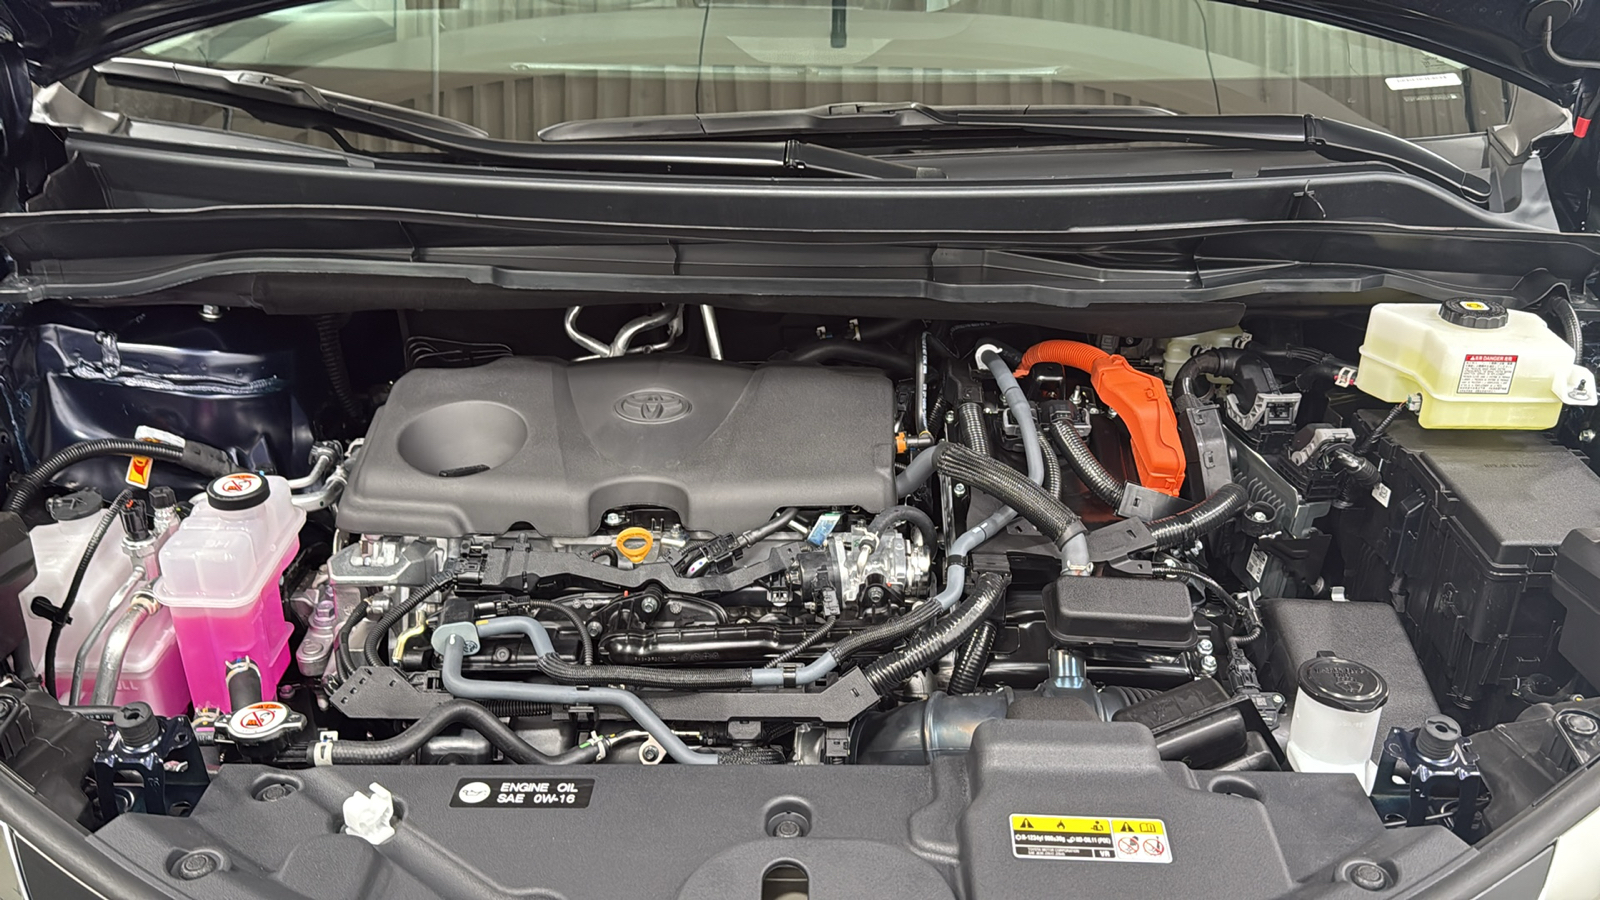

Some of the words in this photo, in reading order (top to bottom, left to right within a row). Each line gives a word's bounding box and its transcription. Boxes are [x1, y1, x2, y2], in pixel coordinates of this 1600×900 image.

[500, 783, 550, 792] ENGINE
[557, 783, 578, 792] OIL
[497, 794, 525, 803] SAE
[533, 794, 576, 803] 0W-16
